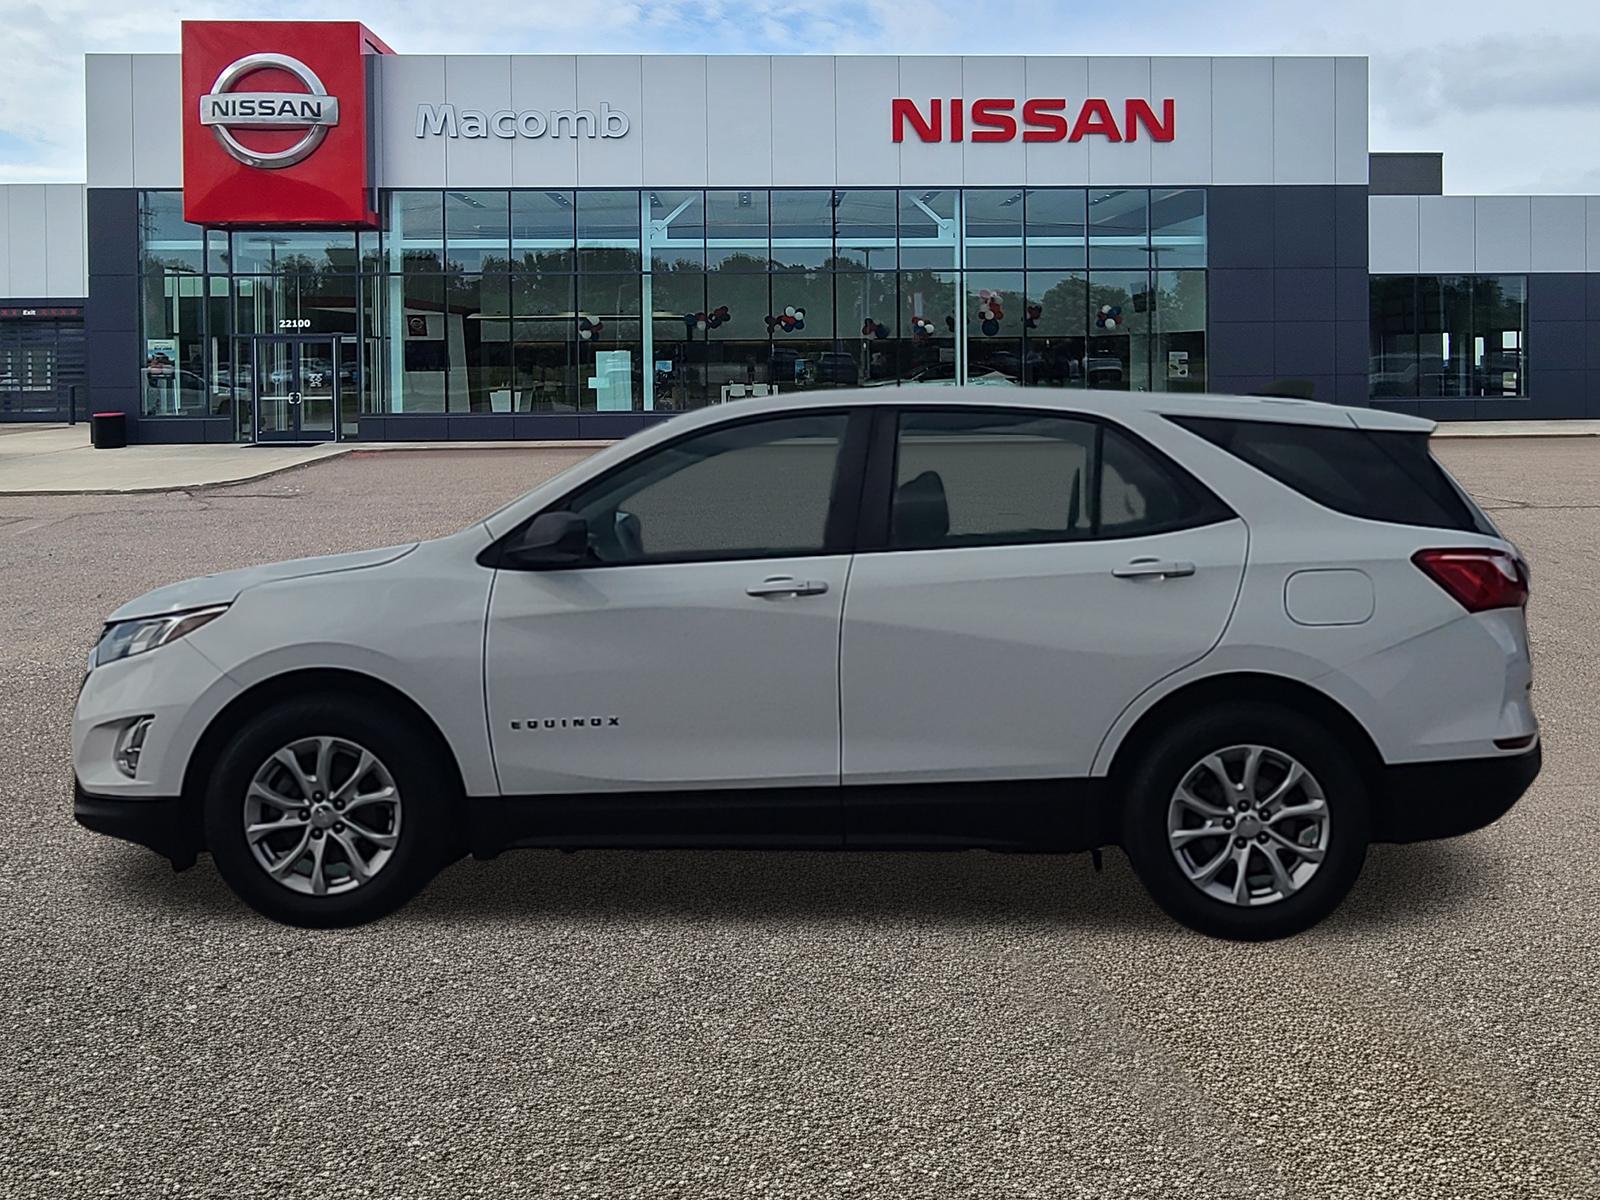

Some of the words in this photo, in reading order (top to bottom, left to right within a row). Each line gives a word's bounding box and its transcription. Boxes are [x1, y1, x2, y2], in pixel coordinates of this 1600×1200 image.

[211, 100, 322, 118] NISSAN
[415, 102, 630, 139] Macomb
[892, 98, 1175, 143] NISSAN
[279, 319, 311, 328] 22100
[510, 717, 620, 730] EQUINOX
